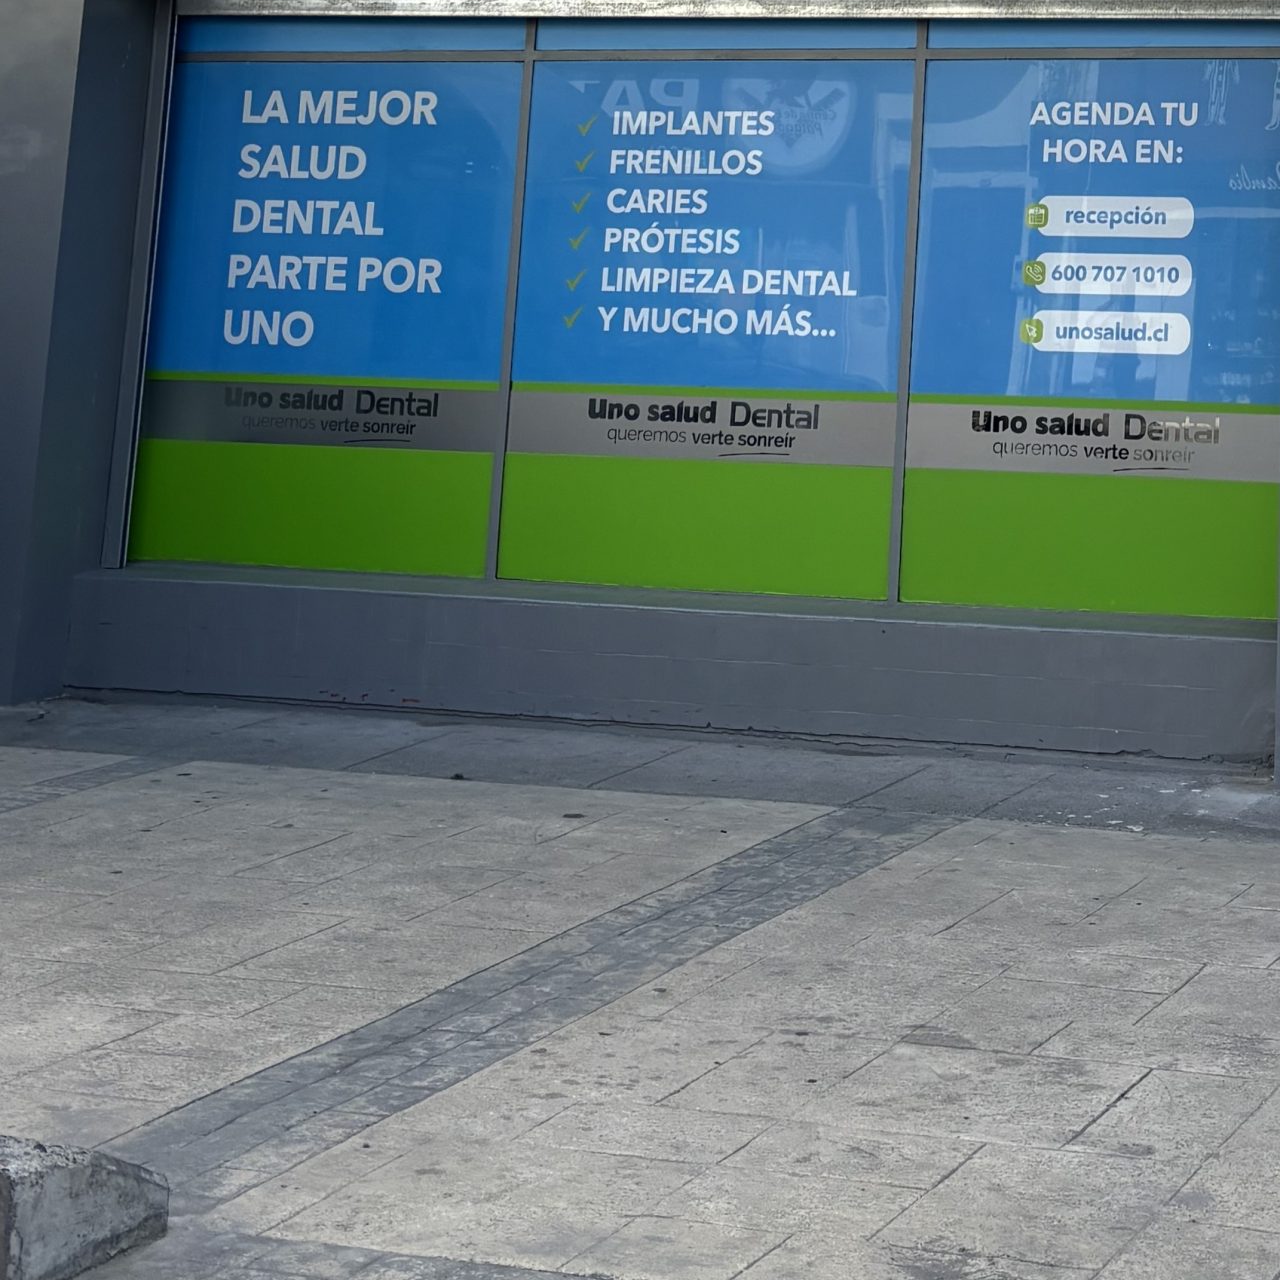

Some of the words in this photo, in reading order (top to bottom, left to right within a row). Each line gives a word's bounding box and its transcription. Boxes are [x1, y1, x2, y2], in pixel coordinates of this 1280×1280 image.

[241, 90, 289, 124] LA
[298, 90, 438, 126] MEJOR
[1029, 102, 1155, 126] AGENDA
[1161, 102, 1199, 127] TU
[612, 110, 775, 136] IMPLANTES
[238, 143, 367, 180] SALUD
[609, 150, 763, 175] FRENILLOS
[1042, 139, 1128, 163] HORA
[1135, 140, 1183, 164] EN:
[606, 188, 708, 214] CARIES
[232, 199, 384, 236] DENTAL
[1065, 206, 1167, 229] recepción
[604, 221, 740, 254] PRÓTESIS
[227, 254, 348, 291] PARTE
[357, 257, 442, 294] POR
[601, 267, 735, 295] LIMPIEZA
[742, 269, 857, 296] DENTAL
[1051, 265, 1087, 282] 600
[1091, 265, 1128, 283] 707
[1132, 266, 1180, 284] 1010
[223, 309, 314, 347] UNO
[598, 307, 618, 332] Y
[623, 307, 738, 334] MUCHO
[746, 304, 836, 337] MÁS...
[1055, 322, 1169, 342] unosalud.cl
[224, 386, 273, 409] Uno
[279, 389, 344, 411] salud
[355, 389, 439, 418] Dental
[587, 398, 640, 421] Uno
[647, 400, 717, 424] salud
[729, 401, 820, 430] Dental
[242, 415, 316, 431] queremos
[320, 417, 360, 432] verte
[607, 427, 686, 445] queremos
[692, 429, 735, 445] verte
[971, 410, 1027, 433] Uno
[1035, 412, 1110, 437] salud
[1124, 413, 1220, 444] Dental
[992, 440, 1078, 458] queremos
[1083, 443, 1130, 460] verte
